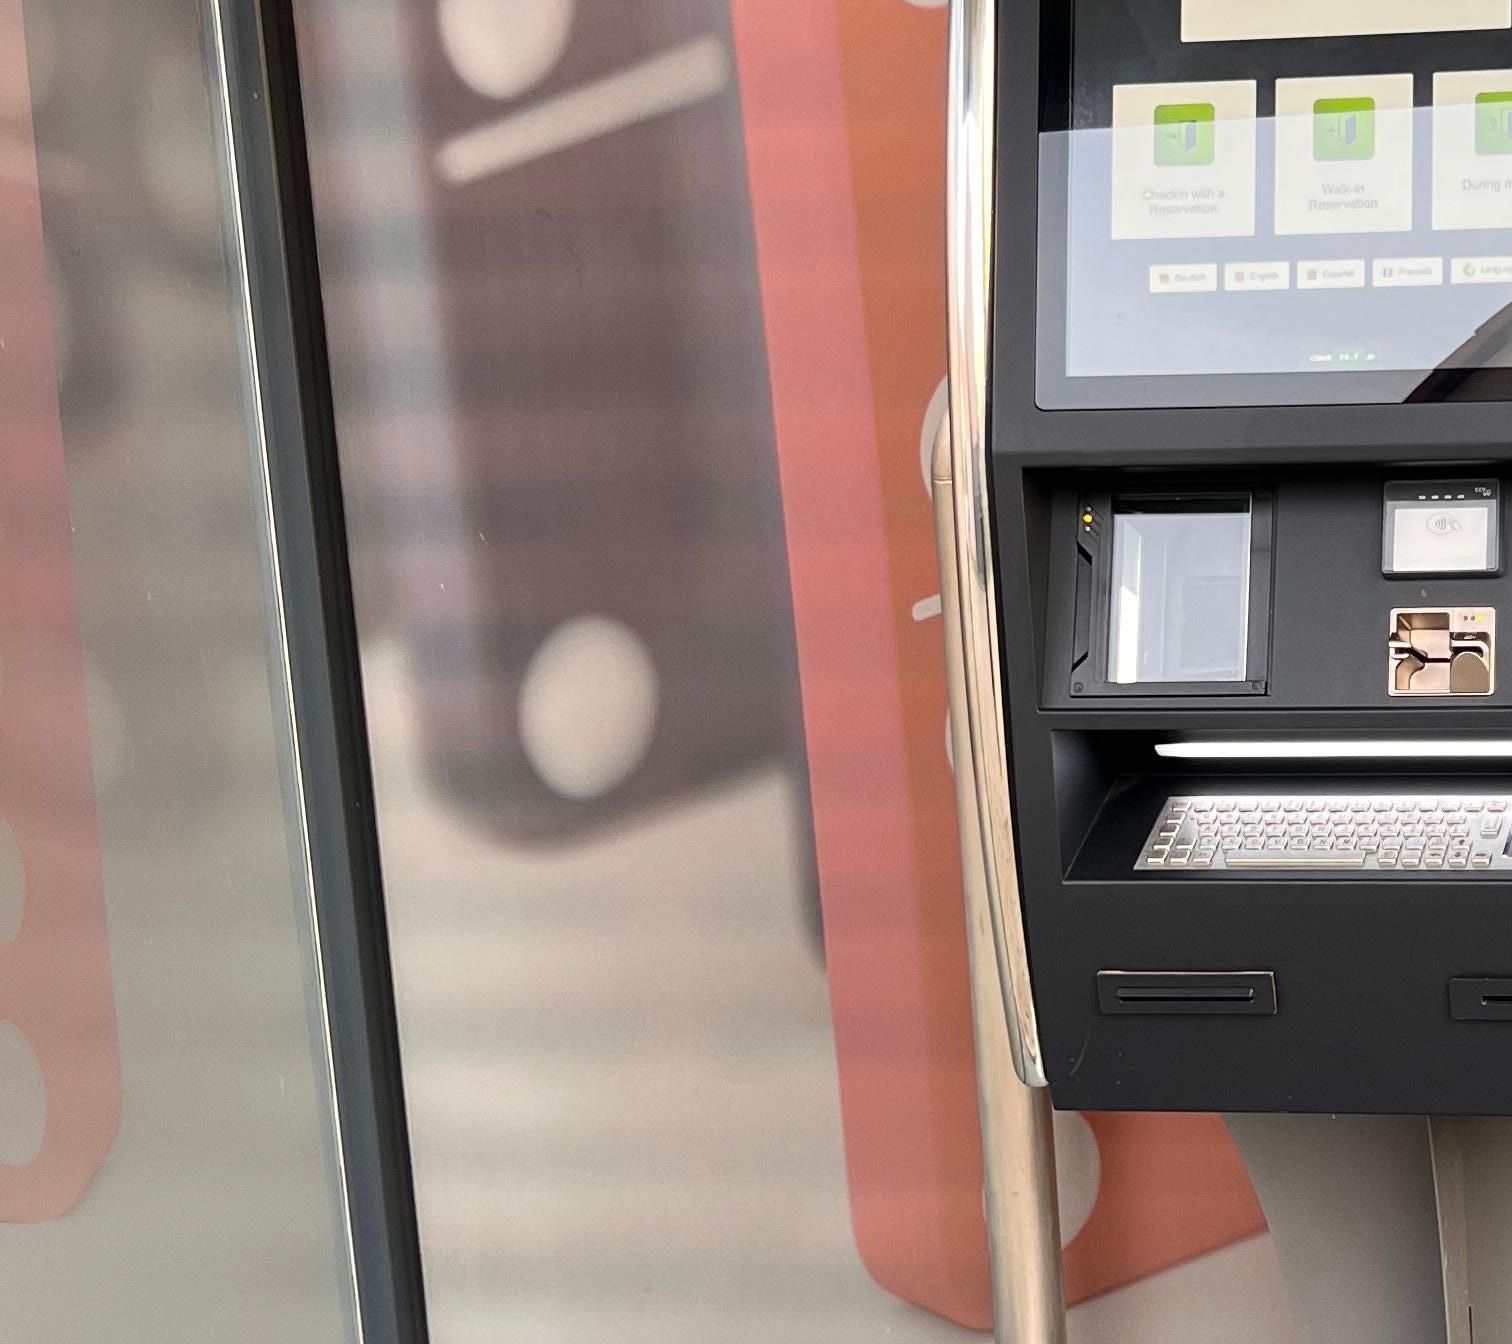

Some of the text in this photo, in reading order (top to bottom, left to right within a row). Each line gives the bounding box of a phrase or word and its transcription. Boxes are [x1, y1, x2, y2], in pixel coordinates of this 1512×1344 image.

[1321, 183, 1365, 195] Walk-in
[1462, 179, 1500, 193] During
[1191, 187, 1214, 200] with
[1150, 203, 1218, 216] Reservation
[1309, 198, 1378, 210] Reservation
